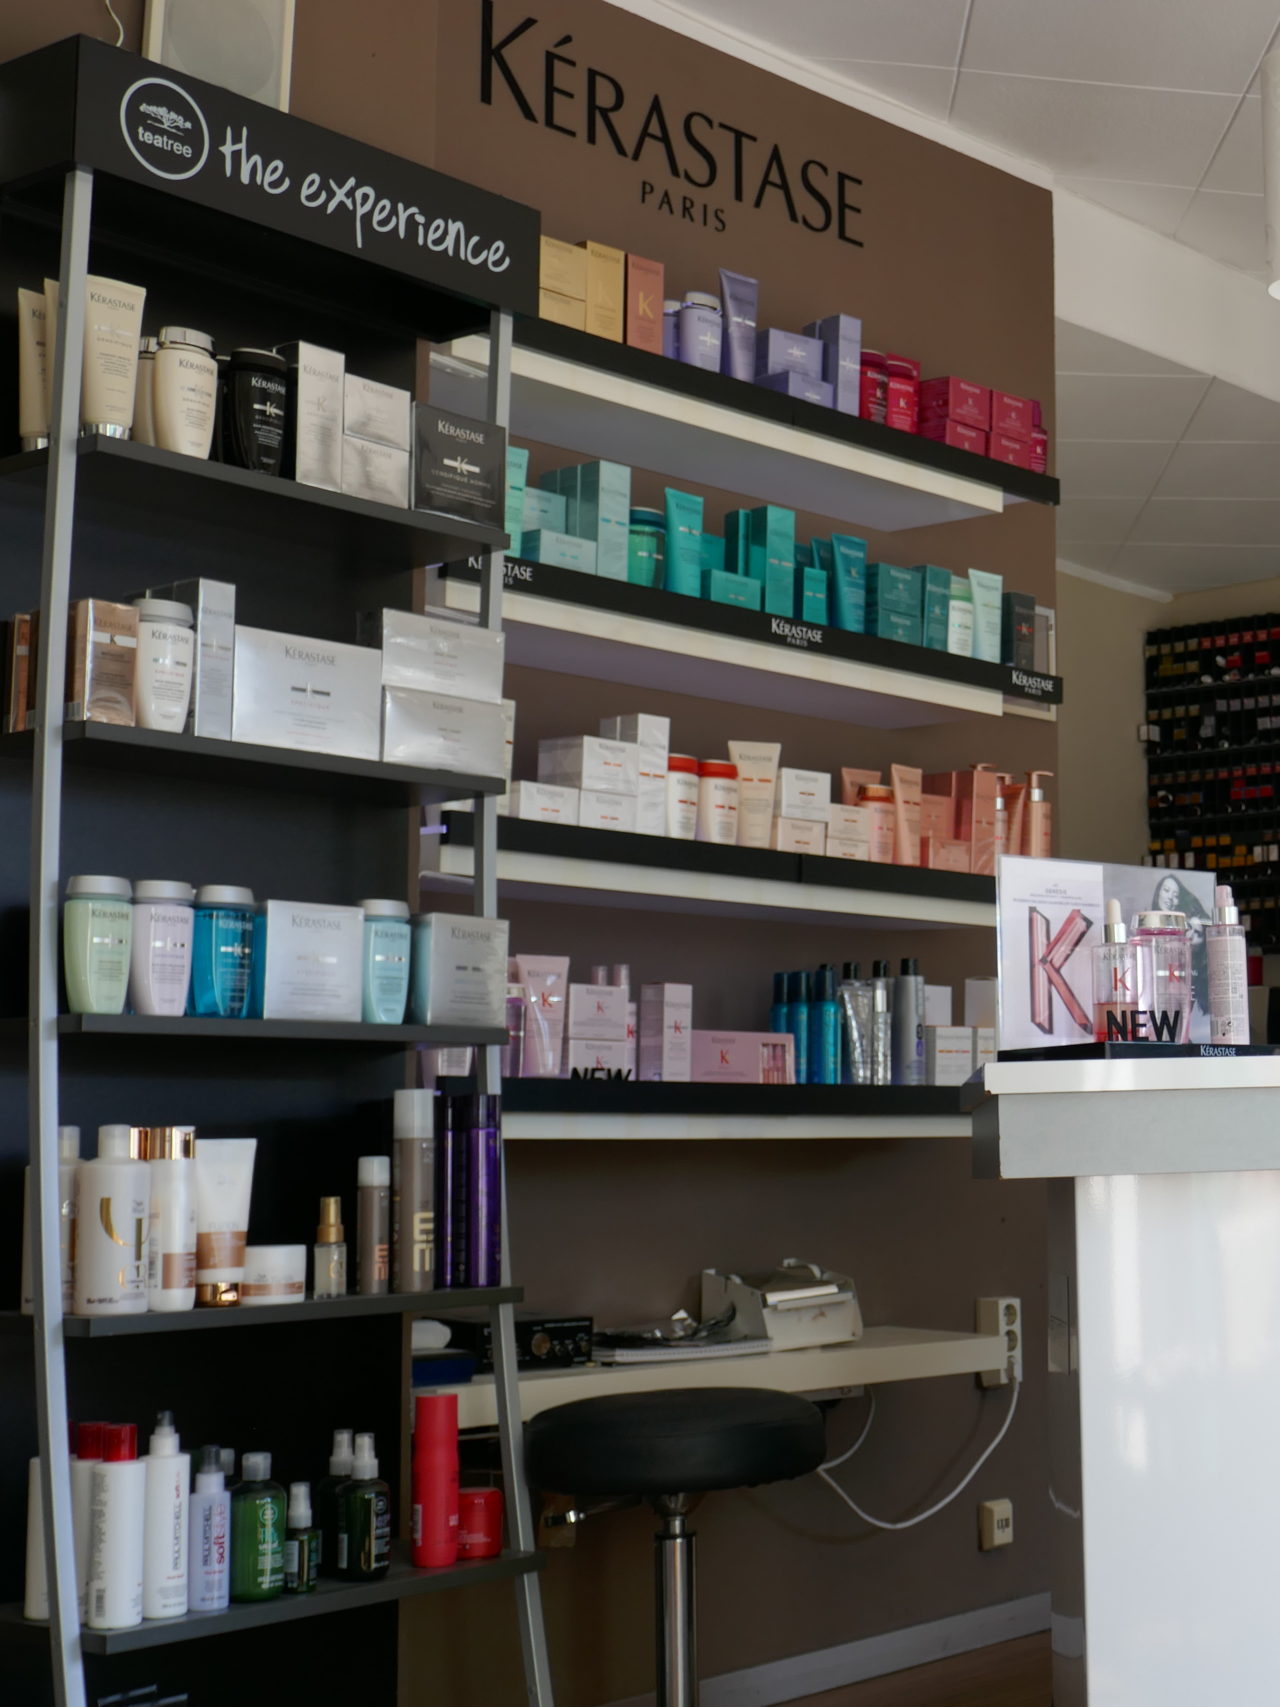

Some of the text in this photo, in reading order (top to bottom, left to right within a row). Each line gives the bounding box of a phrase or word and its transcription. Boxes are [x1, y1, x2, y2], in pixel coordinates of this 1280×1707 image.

[138, 126, 192, 158] teatree
[480, 0, 864, 248] KÉRASTASE
[219, 126, 511, 272] the experience
[641, 180, 727, 233] PARIS
[1106, 1010, 1181, 1043] NEW
[1201, 1044, 1237, 1057] KÉRASTASE
